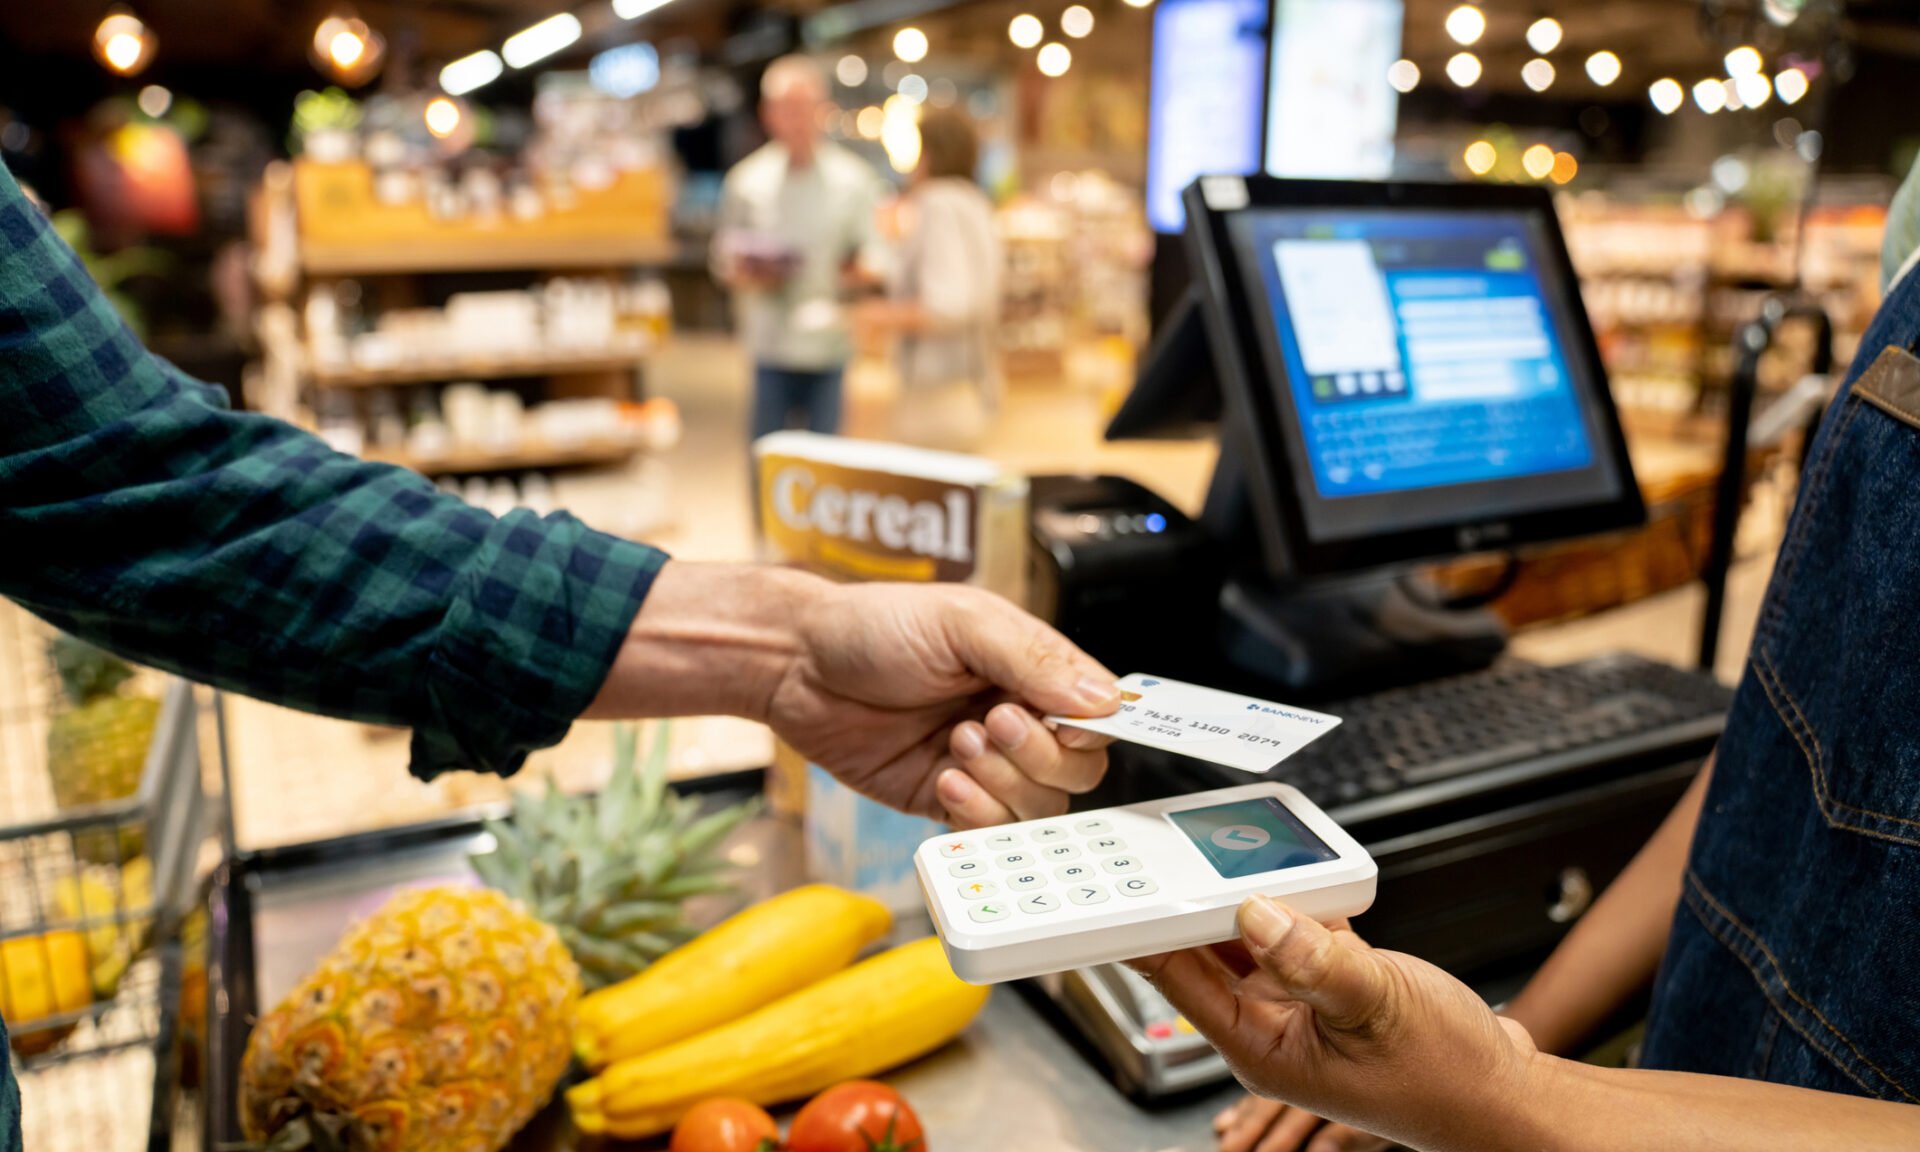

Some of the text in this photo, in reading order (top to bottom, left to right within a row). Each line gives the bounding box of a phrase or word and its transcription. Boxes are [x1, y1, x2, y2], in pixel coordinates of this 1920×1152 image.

[772, 465, 972, 564] Cereal
[1144, 709, 1183, 724] 7655
[1188, 721, 1231, 736] 1100
[1237, 732, 1281, 748] 2079
[1098, 840, 1116, 848] 2
[1053, 847, 1070, 855] 5
[1006, 855, 1023, 863] 8
[1113, 859, 1130, 867] 3
[1066, 867, 1083, 875] 6
[1018, 875, 1035, 883] 9
